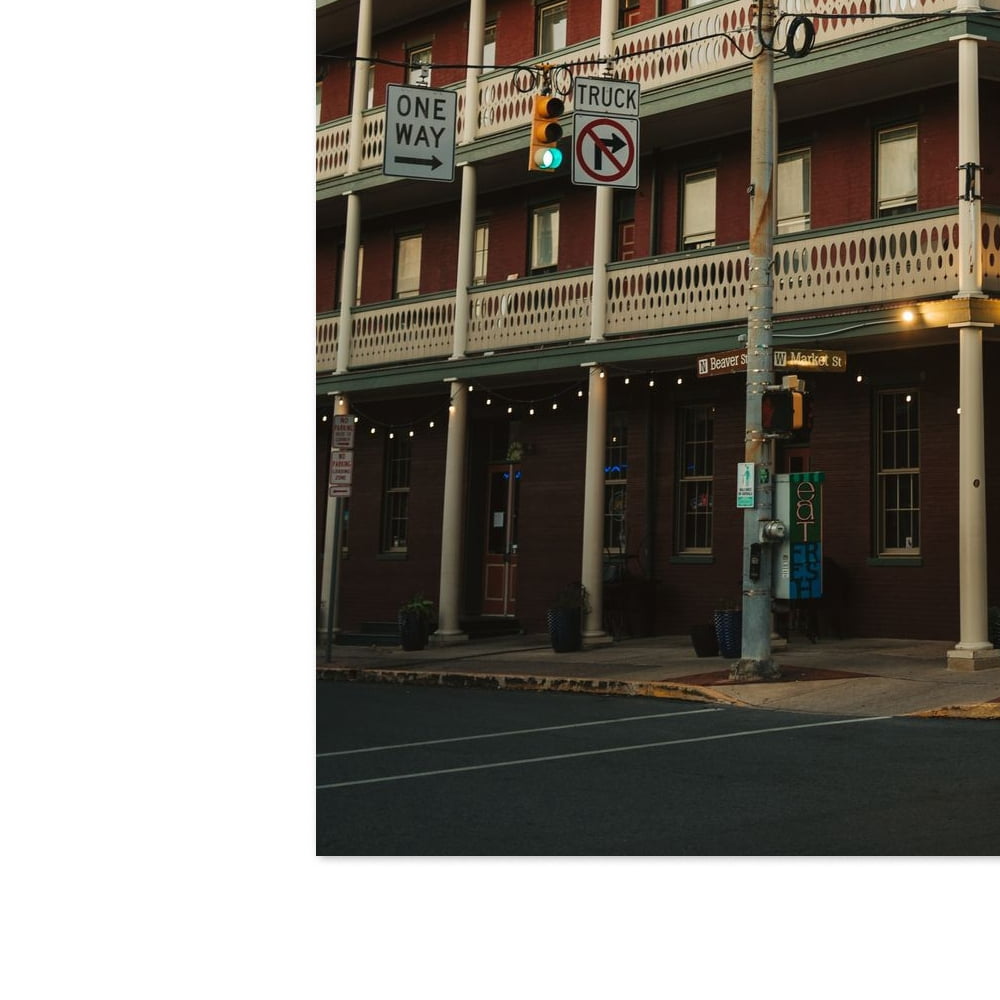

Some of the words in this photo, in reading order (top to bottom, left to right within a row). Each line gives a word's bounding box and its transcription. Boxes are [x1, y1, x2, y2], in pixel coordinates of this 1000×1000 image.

[396, 94, 447, 121] ONE
[577, 84, 637, 110] TRUCK
[395, 123, 446, 148] WAY
[710, 354, 738, 371] Beaver
[775, 353, 786, 365] W
[790, 351, 829, 367] Market
[832, 356, 842, 367] St
